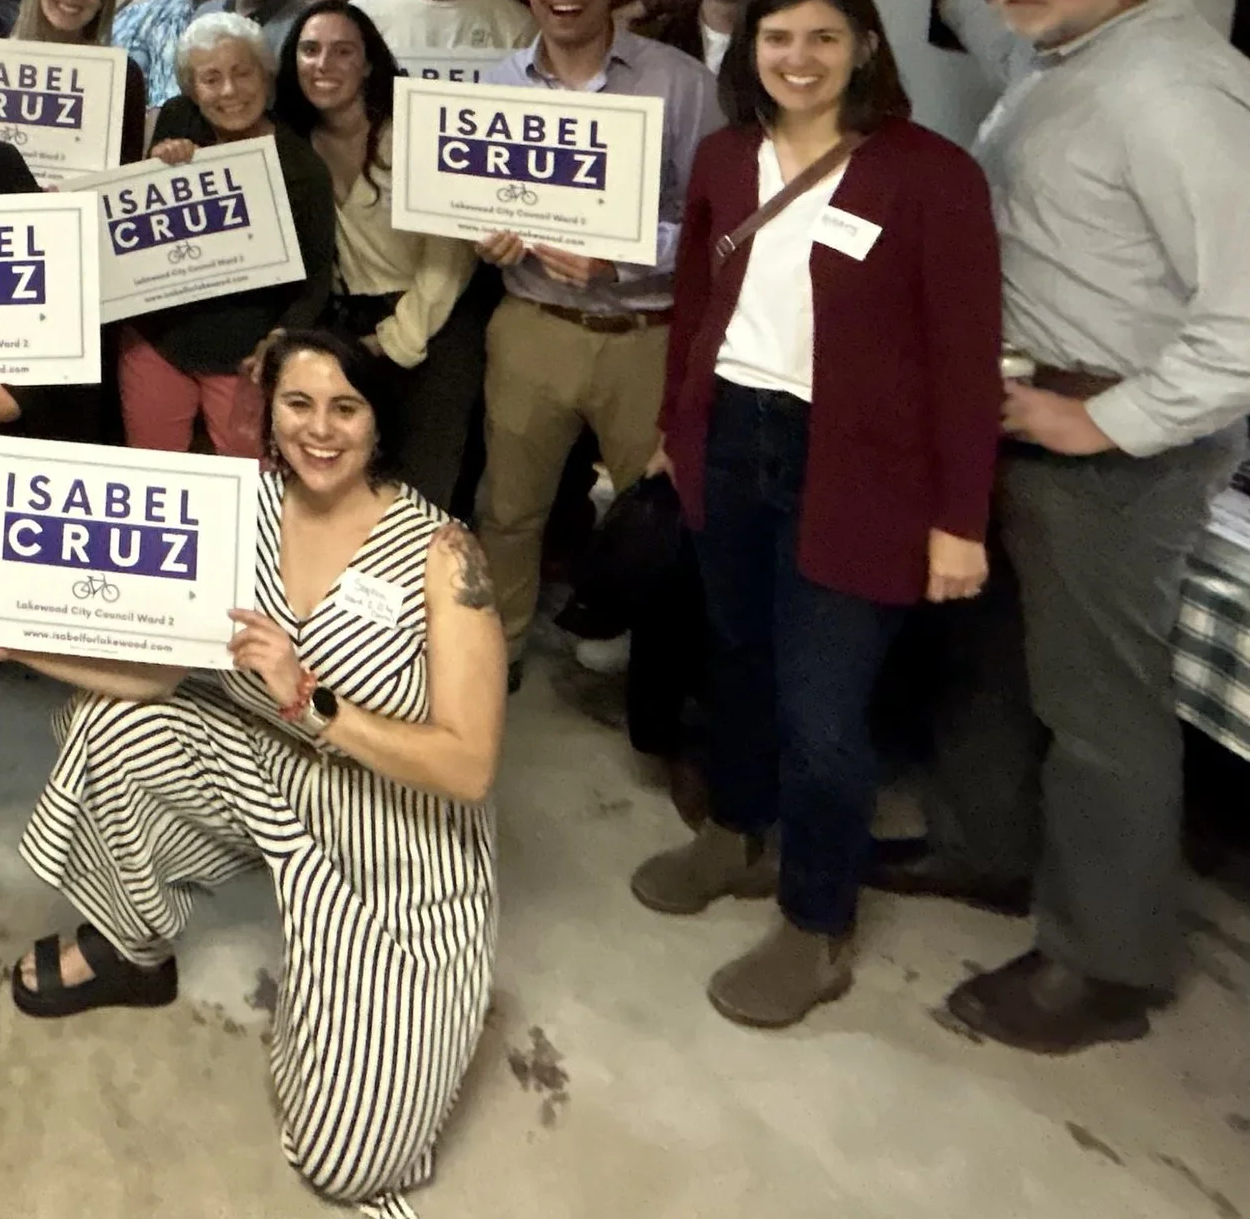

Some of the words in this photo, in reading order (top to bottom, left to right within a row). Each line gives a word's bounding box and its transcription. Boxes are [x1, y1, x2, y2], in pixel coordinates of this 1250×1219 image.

[439, 107, 608, 148] ISABEL
[442, 141, 597, 184] CRUZ
[102, 168, 242, 219] ISABEL
[497, 207, 514, 217] City
[114, 198, 243, 249] CRUZ
[23, 339, 29, 348] 2
[6, 472, 199, 526] ISABEL
[8, 519, 189, 573] CRUZ
[16, 600, 68, 614] Lakewood
[71, 606, 91, 619] City
[94, 608, 134, 621] Council
[137, 614, 165, 625] Ward
[168, 617, 175, 626] 2
[23, 629, 173, 652] www.isabelforlakewood.com
